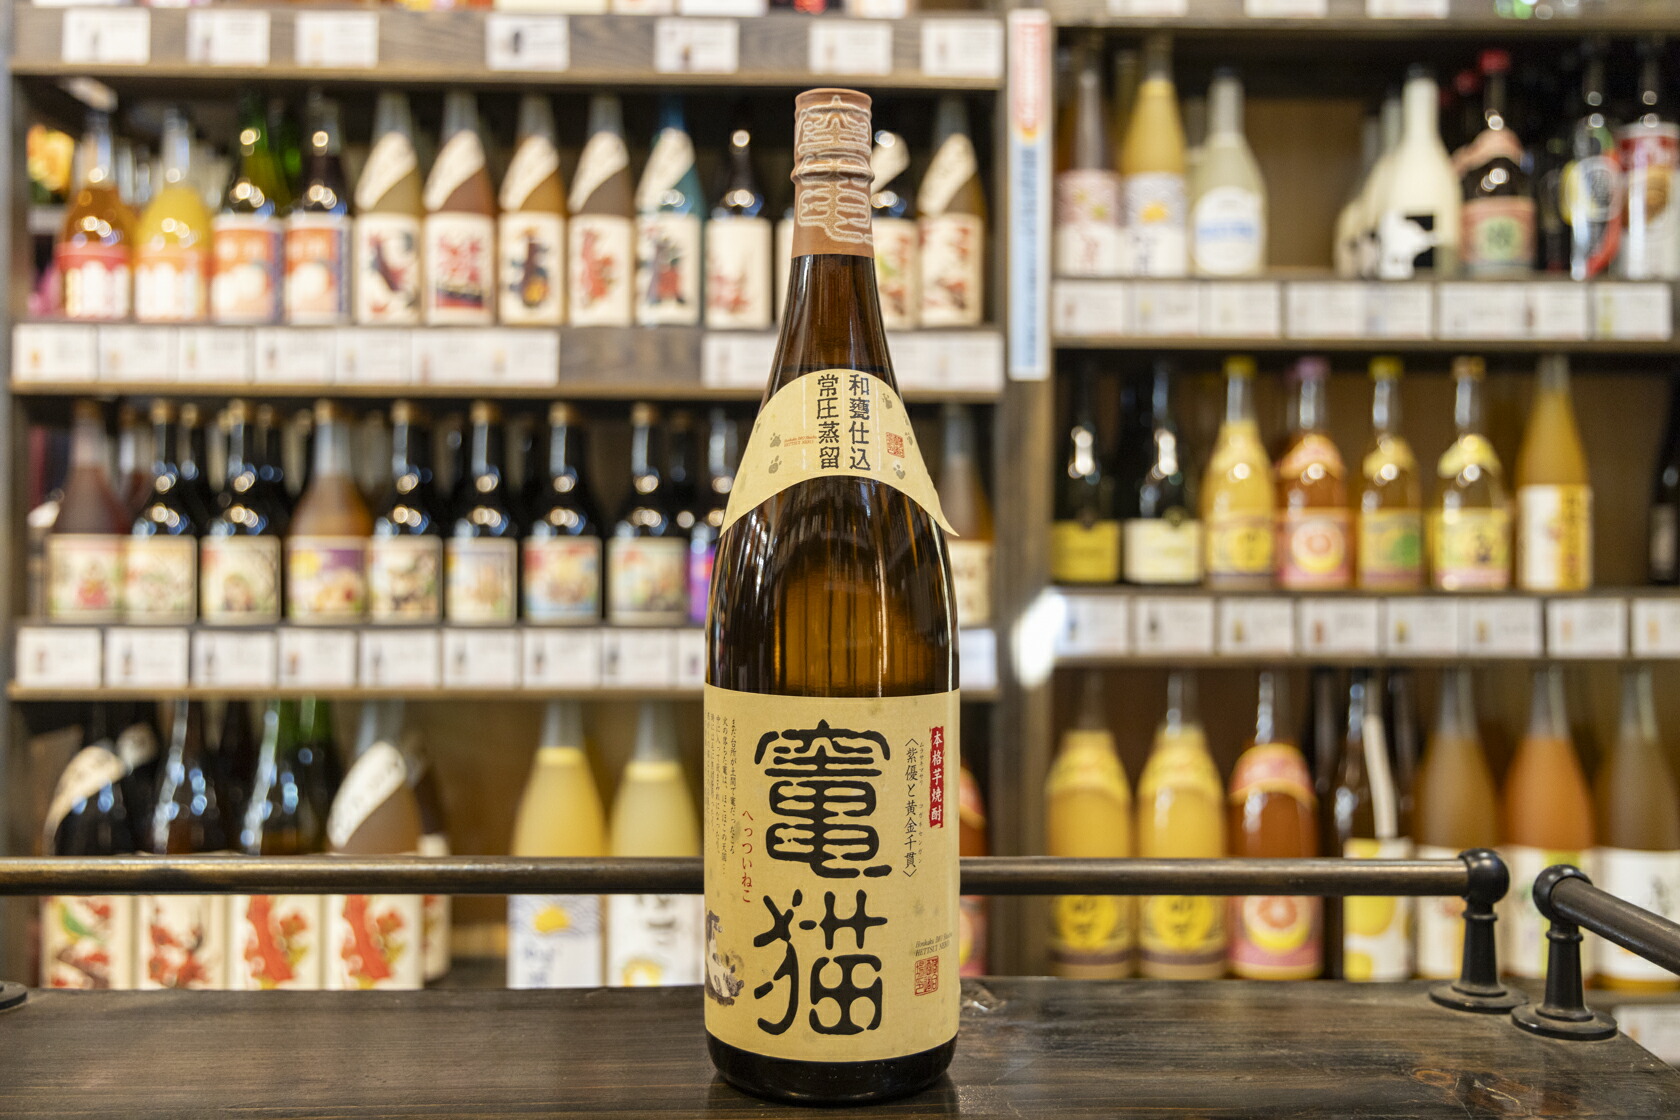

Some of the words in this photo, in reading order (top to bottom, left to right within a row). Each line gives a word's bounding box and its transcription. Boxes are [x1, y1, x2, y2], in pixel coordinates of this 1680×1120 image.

[816, 373, 840, 470] 常圧蒸留
[848, 373, 871, 471] 和甕仕込
[931, 731, 943, 821] 本格芋焼酎
[741, 810, 754, 903] へっついねこ
